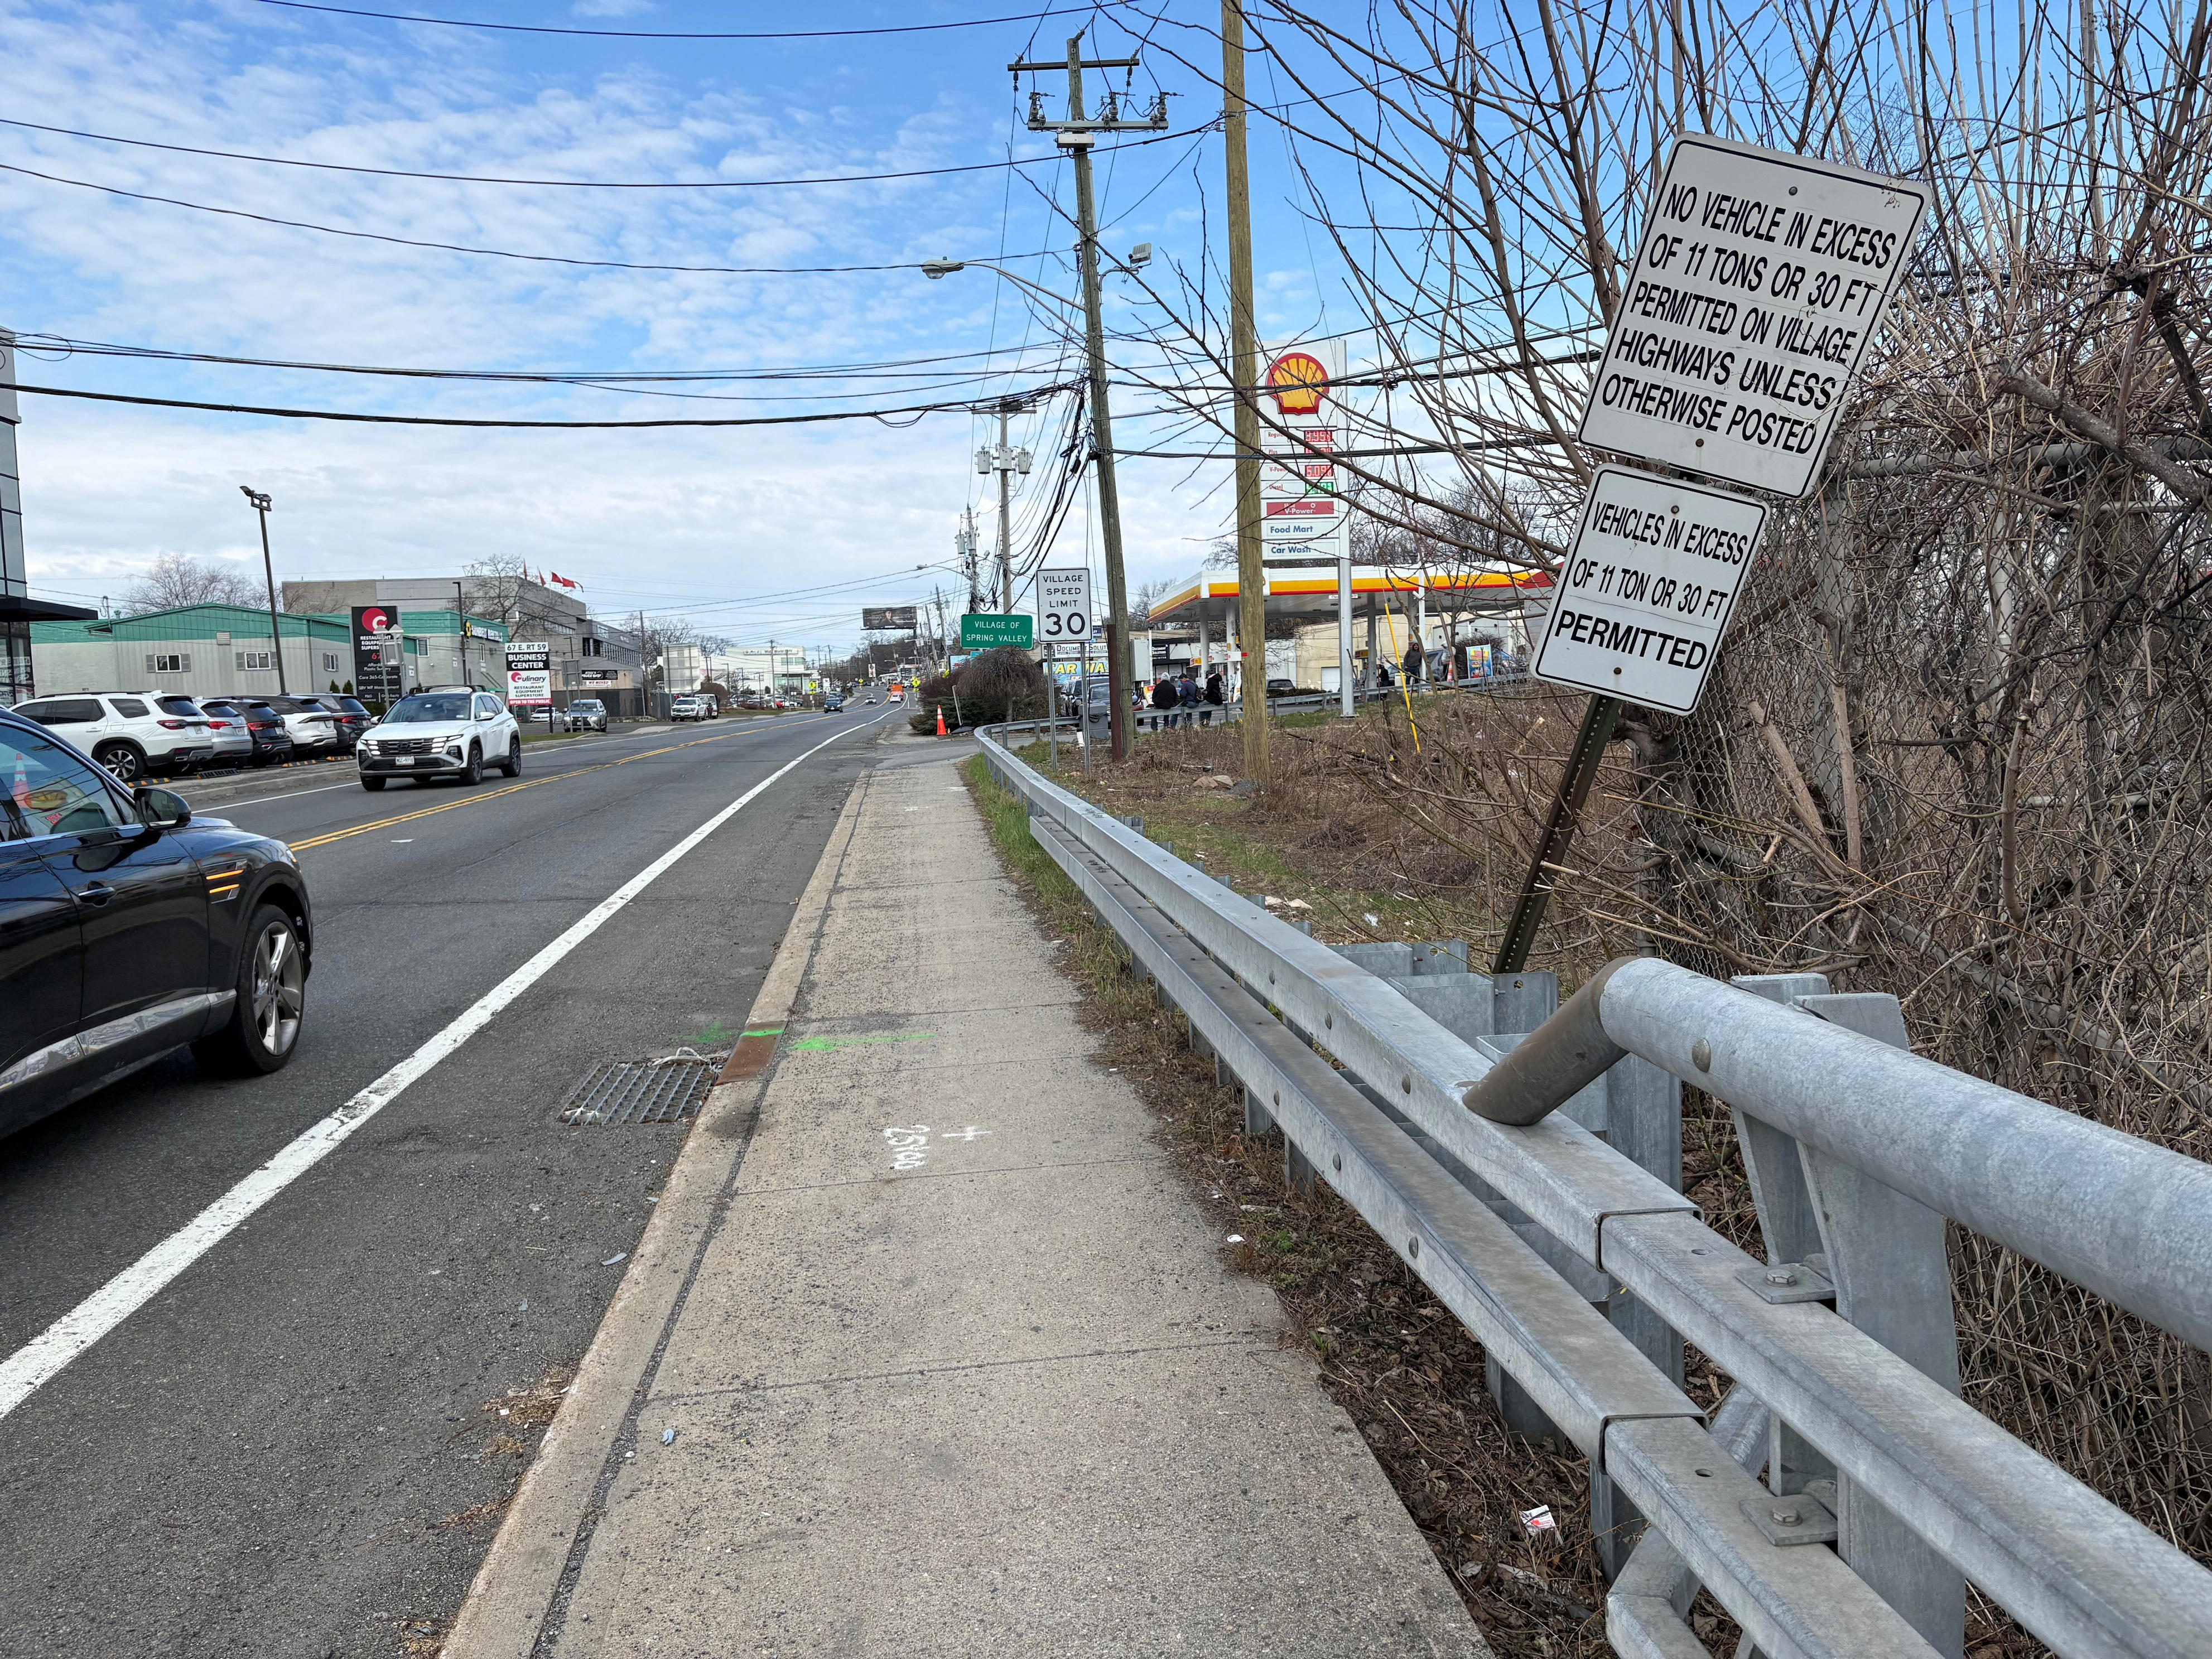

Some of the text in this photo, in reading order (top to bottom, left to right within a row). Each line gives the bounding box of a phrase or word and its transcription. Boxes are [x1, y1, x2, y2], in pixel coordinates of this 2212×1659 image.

[1663, 183, 1896, 269] NO VEHICLE IN EXCESS
[1649, 233, 1877, 316] OF 11 TONS OR 30 FT
[1630, 281, 1857, 365] PERMITTED ON VILLAGE
[1615, 327, 1837, 411] HIGHWAYS UNLESS
[1602, 373, 1815, 455] OTHERWISE POSTED
[1270, 525, 1290, 533] Food
[1288, 545, 1311, 553] Wash
[1592, 501, 1748, 566] VEHICLES IN EXCESS
[1043, 575, 1083, 583] VILLAGE
[1572, 558, 1728, 620] OF 11 TON OR 30 FT
[1045, 612, 1086, 636] 30
[1554, 610, 1707, 671] PERMITTED
[513, 673, 547, 683] Culinary
